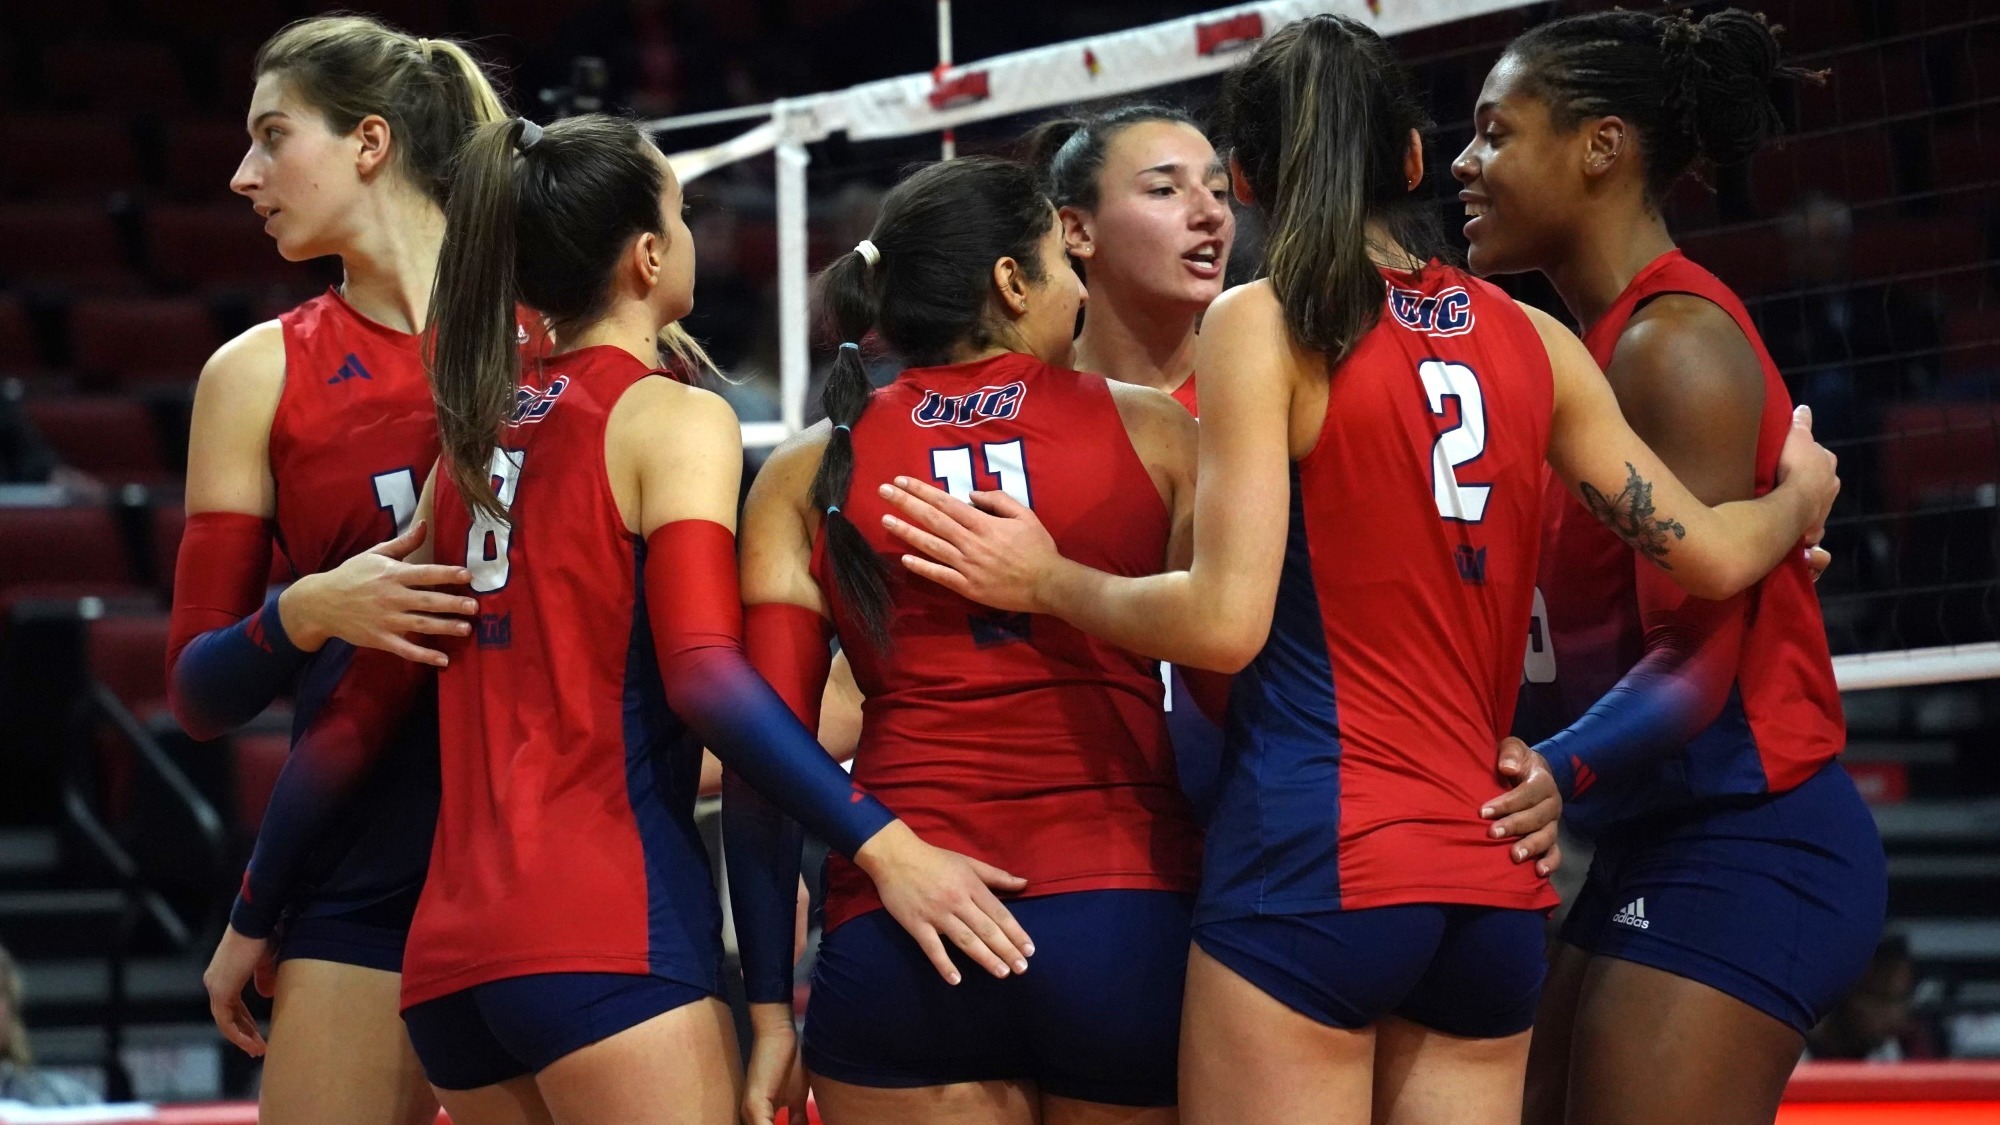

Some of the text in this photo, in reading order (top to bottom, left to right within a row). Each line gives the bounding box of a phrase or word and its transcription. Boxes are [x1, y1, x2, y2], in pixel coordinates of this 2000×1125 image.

[1388, 283, 1473, 335] UIC
[913, 382, 1025, 427] UIC
[1418, 359, 1493, 524] 2
[466, 446, 525, 594] 8
[1612, 912, 1650, 929] adidas
